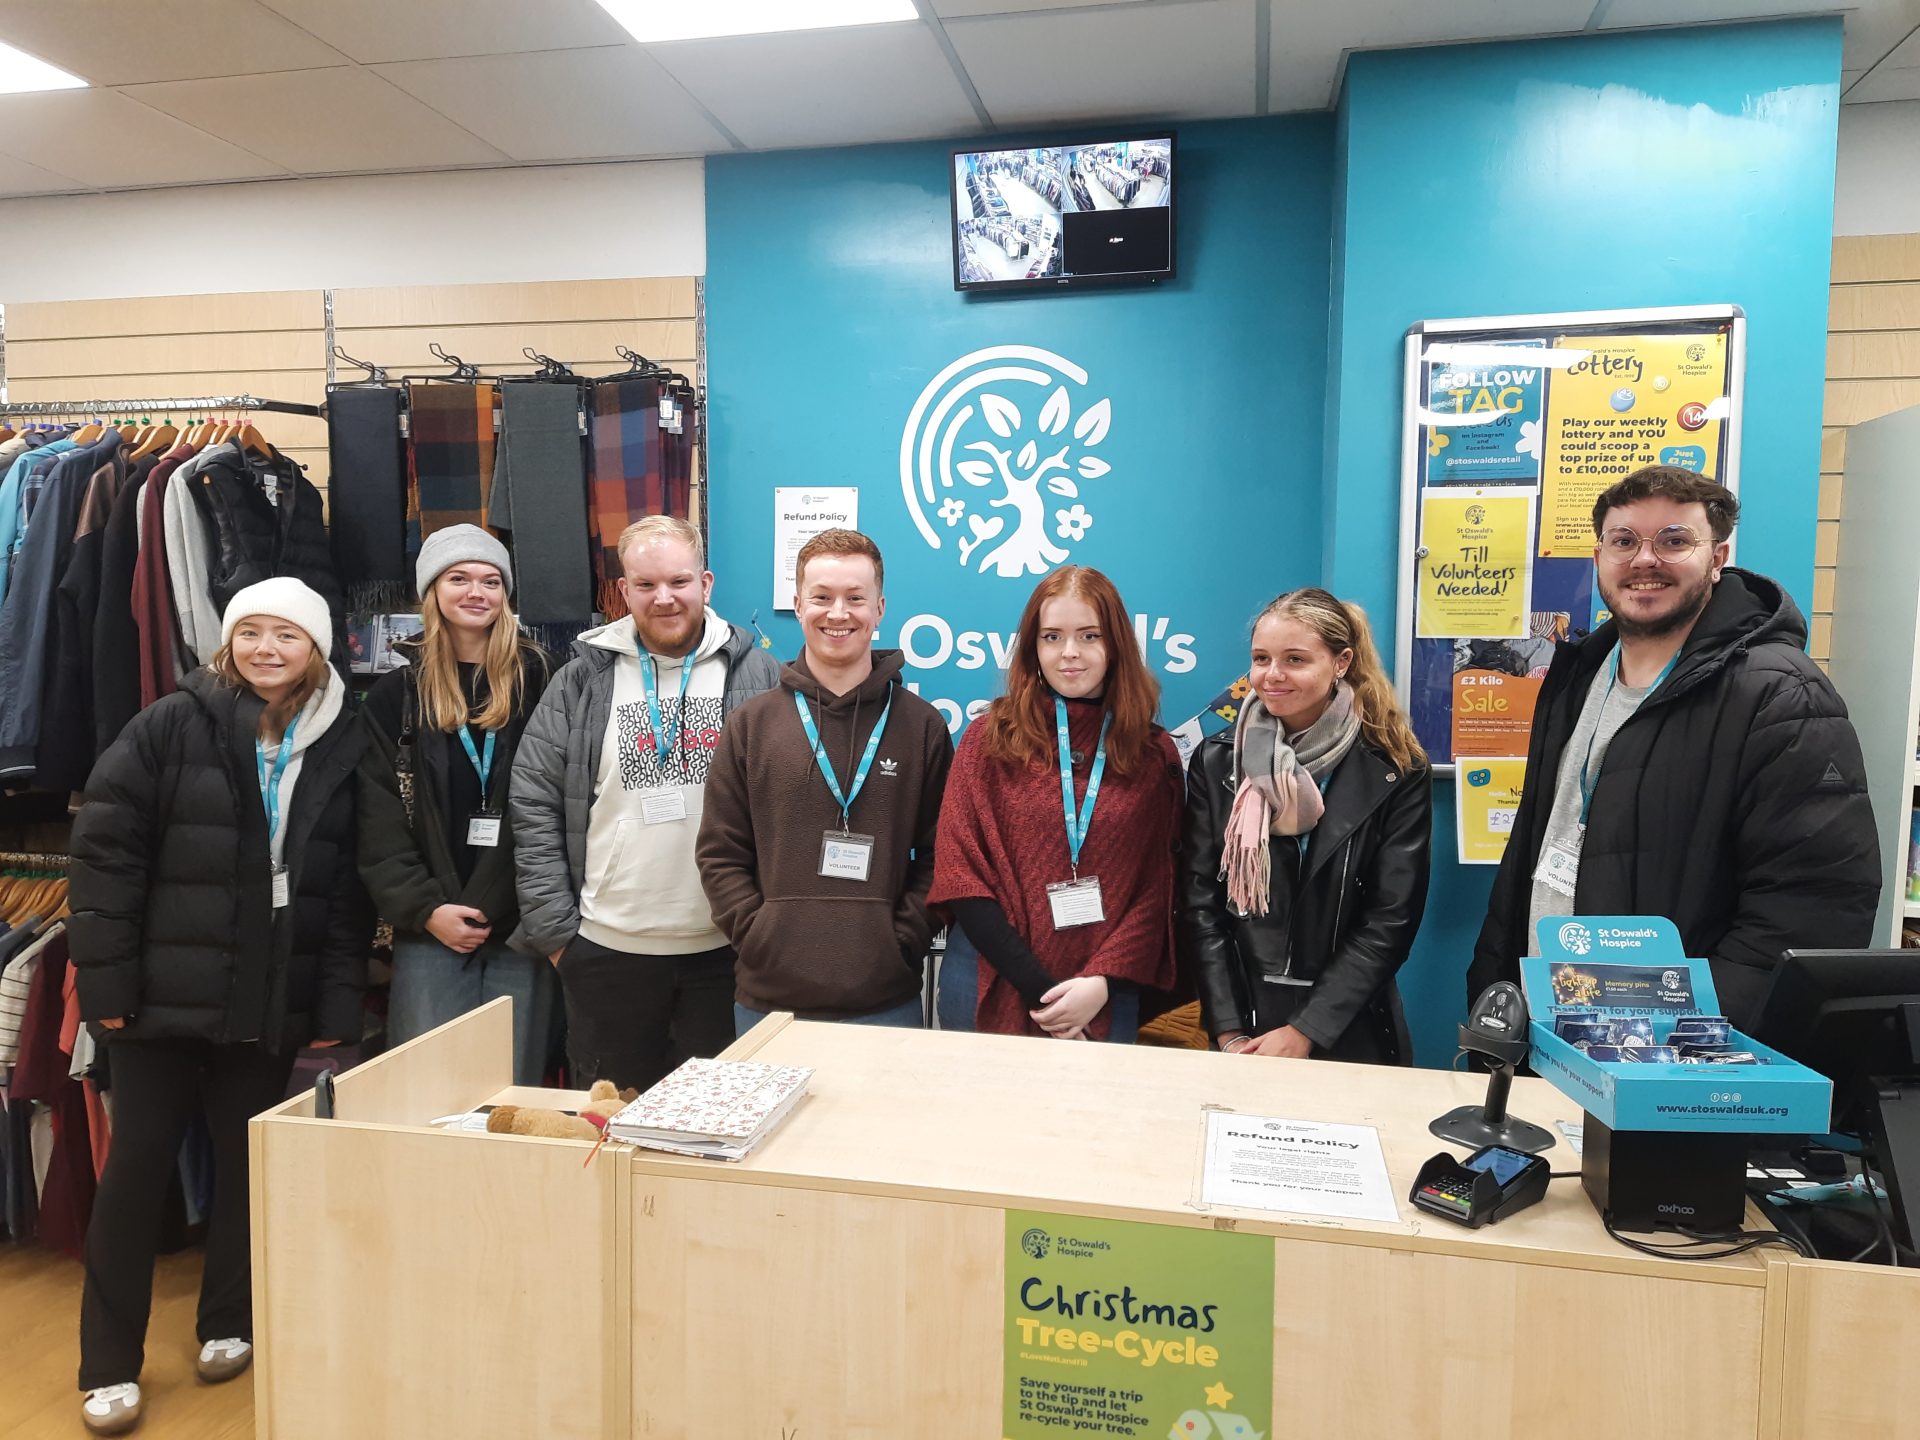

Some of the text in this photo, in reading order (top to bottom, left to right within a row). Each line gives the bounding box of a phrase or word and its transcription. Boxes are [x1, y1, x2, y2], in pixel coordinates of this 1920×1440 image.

[1439, 369, 1536, 388] FOLLOW
[1448, 387, 1524, 415] TAG
[1562, 417, 1667, 428] Play our weekly
[1561, 429, 1666, 440] lottery and YOU
[1561, 442, 1597, 451] could
[1600, 443, 1639, 453] scoop
[1446, 456, 1521, 467] @stoswaldsretail
[1560, 453, 1655, 464] top prize of up
[1559, 465, 1629, 475] to £10,000!
[784, 512, 848, 522] Refund Policy
[1460, 546, 1488, 563] Till
[1431, 563, 1516, 580] Volunteers
[1437, 580, 1508, 596] Needed!
[1460, 675, 1504, 685] £2 Kilo
[1459, 688, 1509, 713] Sale
[637, 728, 720, 752] HGO
[828, 862, 860, 871] VOLUNTEER
[1598, 928, 1658, 938] St Oswald's
[1600, 939, 1642, 949] Hospice
[1605, 980, 1650, 989] Memory pins
[1546, 1004, 1584, 1014] Thank
[1609, 1006, 1627, 1015] for
[1628, 1007, 1656, 1018] your
[1659, 1006, 1705, 1018] support
[1535, 1045, 1604, 1099] Thank you for your support
[1656, 1104, 1789, 1117] www.stoswaldsuk.org
[1227, 1131, 1360, 1149] Refund Policy
[1658, 1204, 1695, 1215] oxhoo
[1057, 1237, 1111, 1250] St Oswald's
[1057, 1246, 1094, 1258] Hospice
[1020, 1276, 1219, 1333] Christmas
[1016, 1317, 1219, 1367] Tree-Cycle
[1020, 1376, 1050, 1389] Save
[1053, 1382, 1106, 1397] yourself
[1120, 1390, 1143, 1403] trip
[1020, 1388, 1127, 1411] to the tip and let
[1020, 1399, 1149, 1425] St Oswald's Hospice
[1020, 1411, 1136, 1436] re-cycle your tree.
